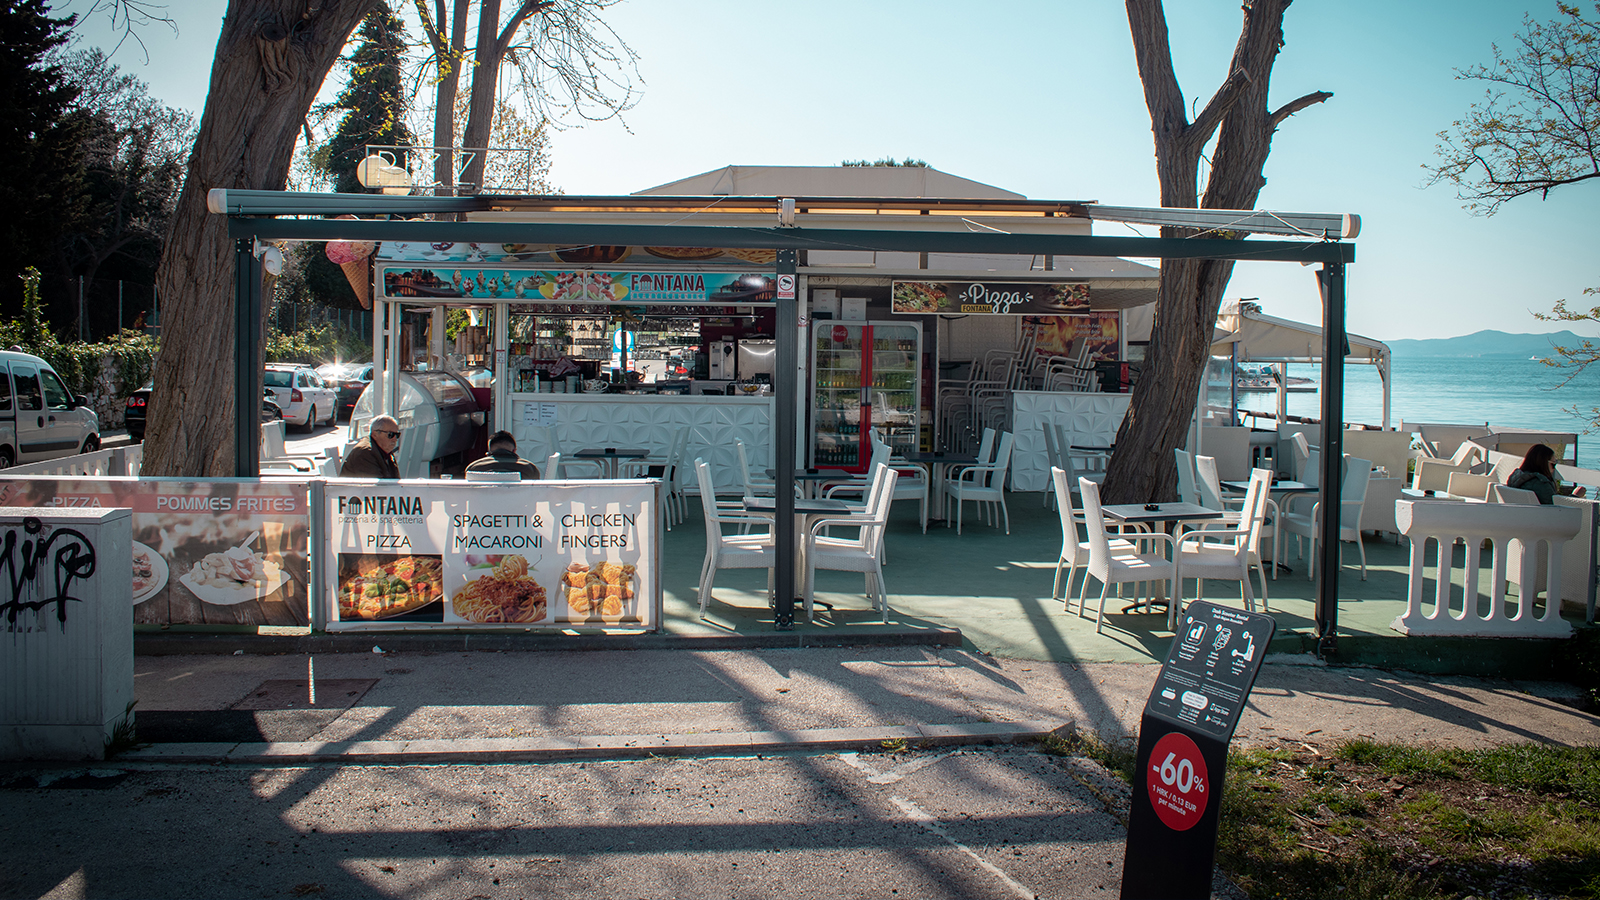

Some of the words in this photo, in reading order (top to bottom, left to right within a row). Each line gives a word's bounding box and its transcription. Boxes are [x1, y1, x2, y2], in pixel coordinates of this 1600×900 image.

[631, 274, 705, 291] FONTANA
[968, 283, 1023, 314] Pizza
[52, 497, 102, 508] PIZZA
[157, 497, 232, 510] POMMES
[237, 498, 295, 511] FRITES
[338, 496, 423, 515] FONTANA
[338, 515, 369, 524] pizzeria
[371, 515, 377, 523] &
[380, 515, 423, 526] spagetteria
[453, 514, 527, 528] SPAGETTI
[532, 514, 543, 528] &
[561, 513, 635, 527] CHICKEN
[367, 534, 412, 547] PIZZA
[455, 535, 543, 548] MACARONI
[562, 534, 627, 548] FINGERS
[1153, 752, 1204, 793] -60%
[1156, 786, 1168, 798] HRK
[1172, 794, 1184, 806] 0.13
[1185, 800, 1197, 812] EUR
[1168, 801, 1186, 815] minute
